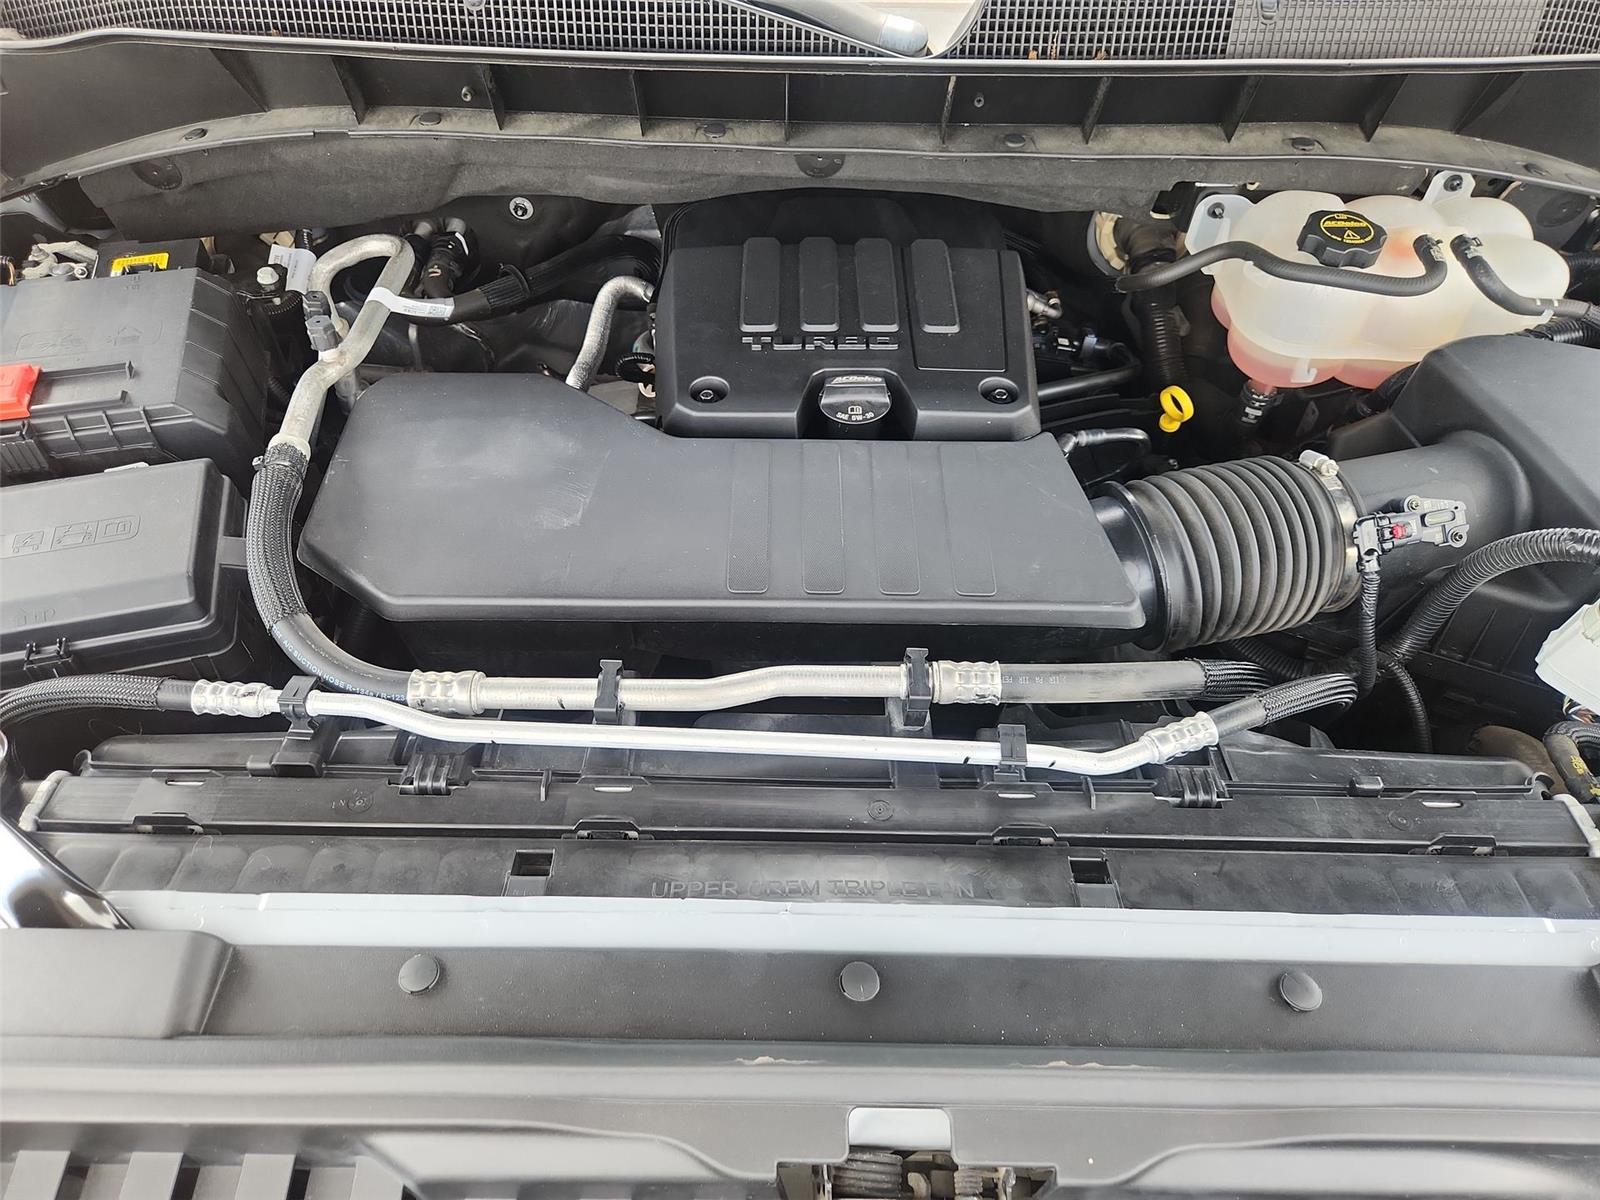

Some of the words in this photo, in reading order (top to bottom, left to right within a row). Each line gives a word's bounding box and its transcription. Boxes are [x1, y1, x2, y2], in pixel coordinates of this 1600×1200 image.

[742, 335, 898, 350] TURBO
[831, 375, 883, 384] ACDelco
[835, 411, 850, 420] SAE
[293, 650, 322, 677] SUCTION
[323, 673, 345, 688] HOSE
[345, 683, 374, 697] R-134a
[380, 692, 408, 702] R-123
[651, 880, 739, 898] UPPER
